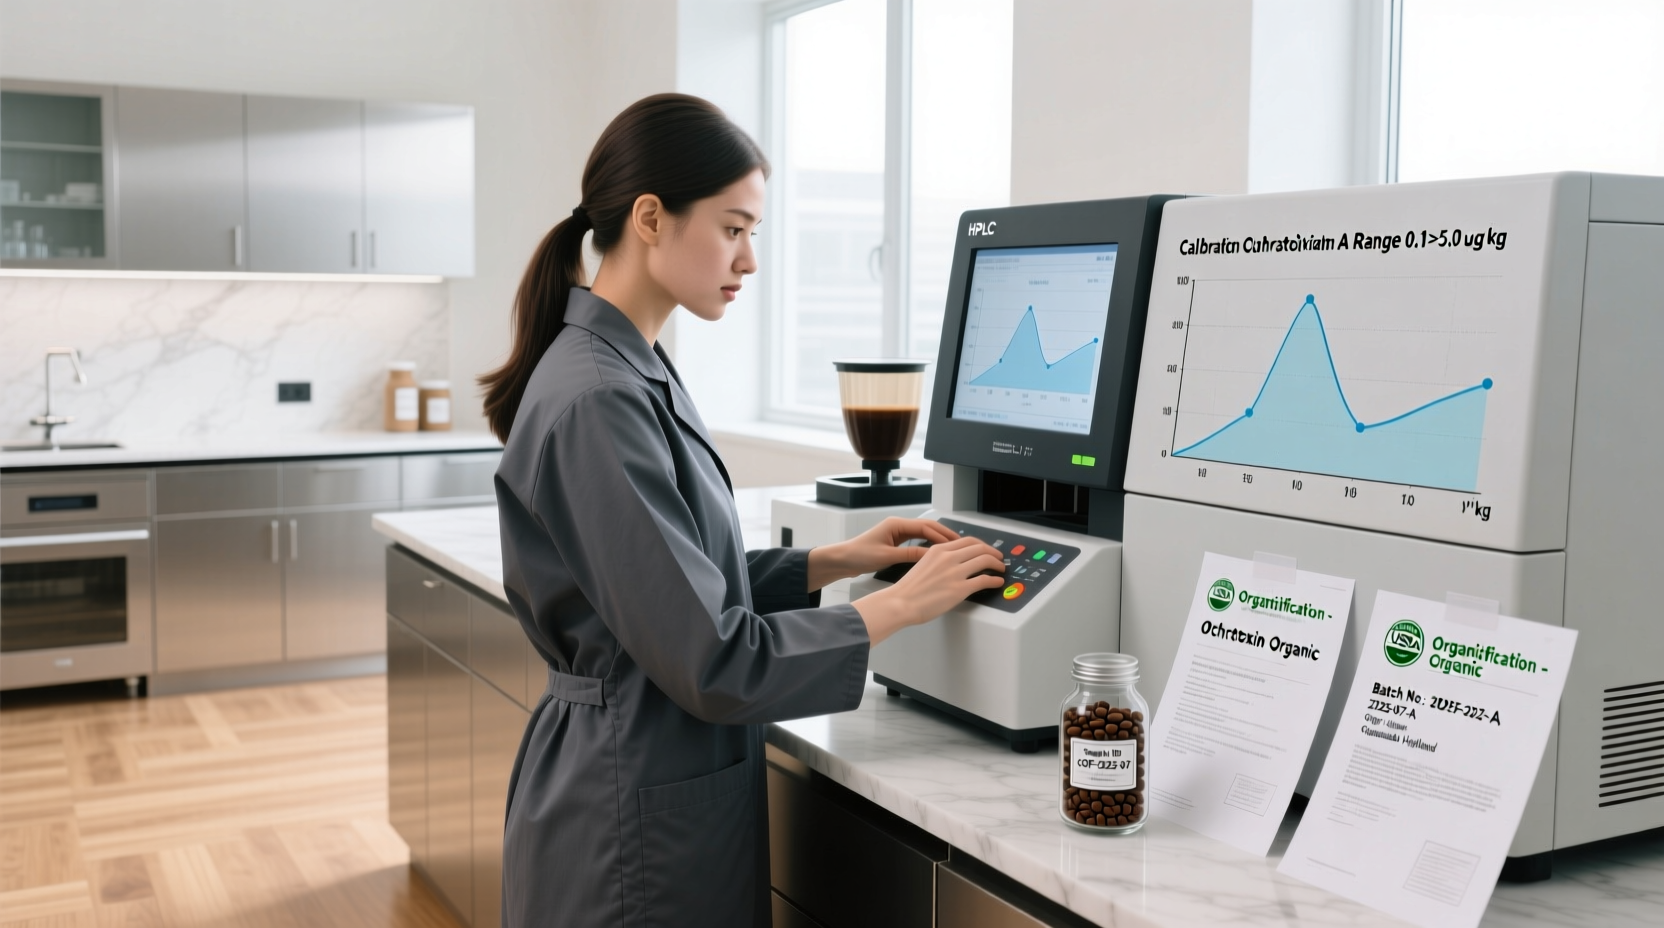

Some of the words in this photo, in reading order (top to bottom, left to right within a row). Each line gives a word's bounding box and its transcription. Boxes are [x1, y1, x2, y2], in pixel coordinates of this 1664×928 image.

[968, 221, 997, 236] HPLC
[1337, 233, 1349, 250] A
[1353, 232, 1401, 254] Range
[1269, 636, 1320, 661] Organic
[1429, 654, 1483, 678] Organic
[1372, 682, 1403, 701] Batch
